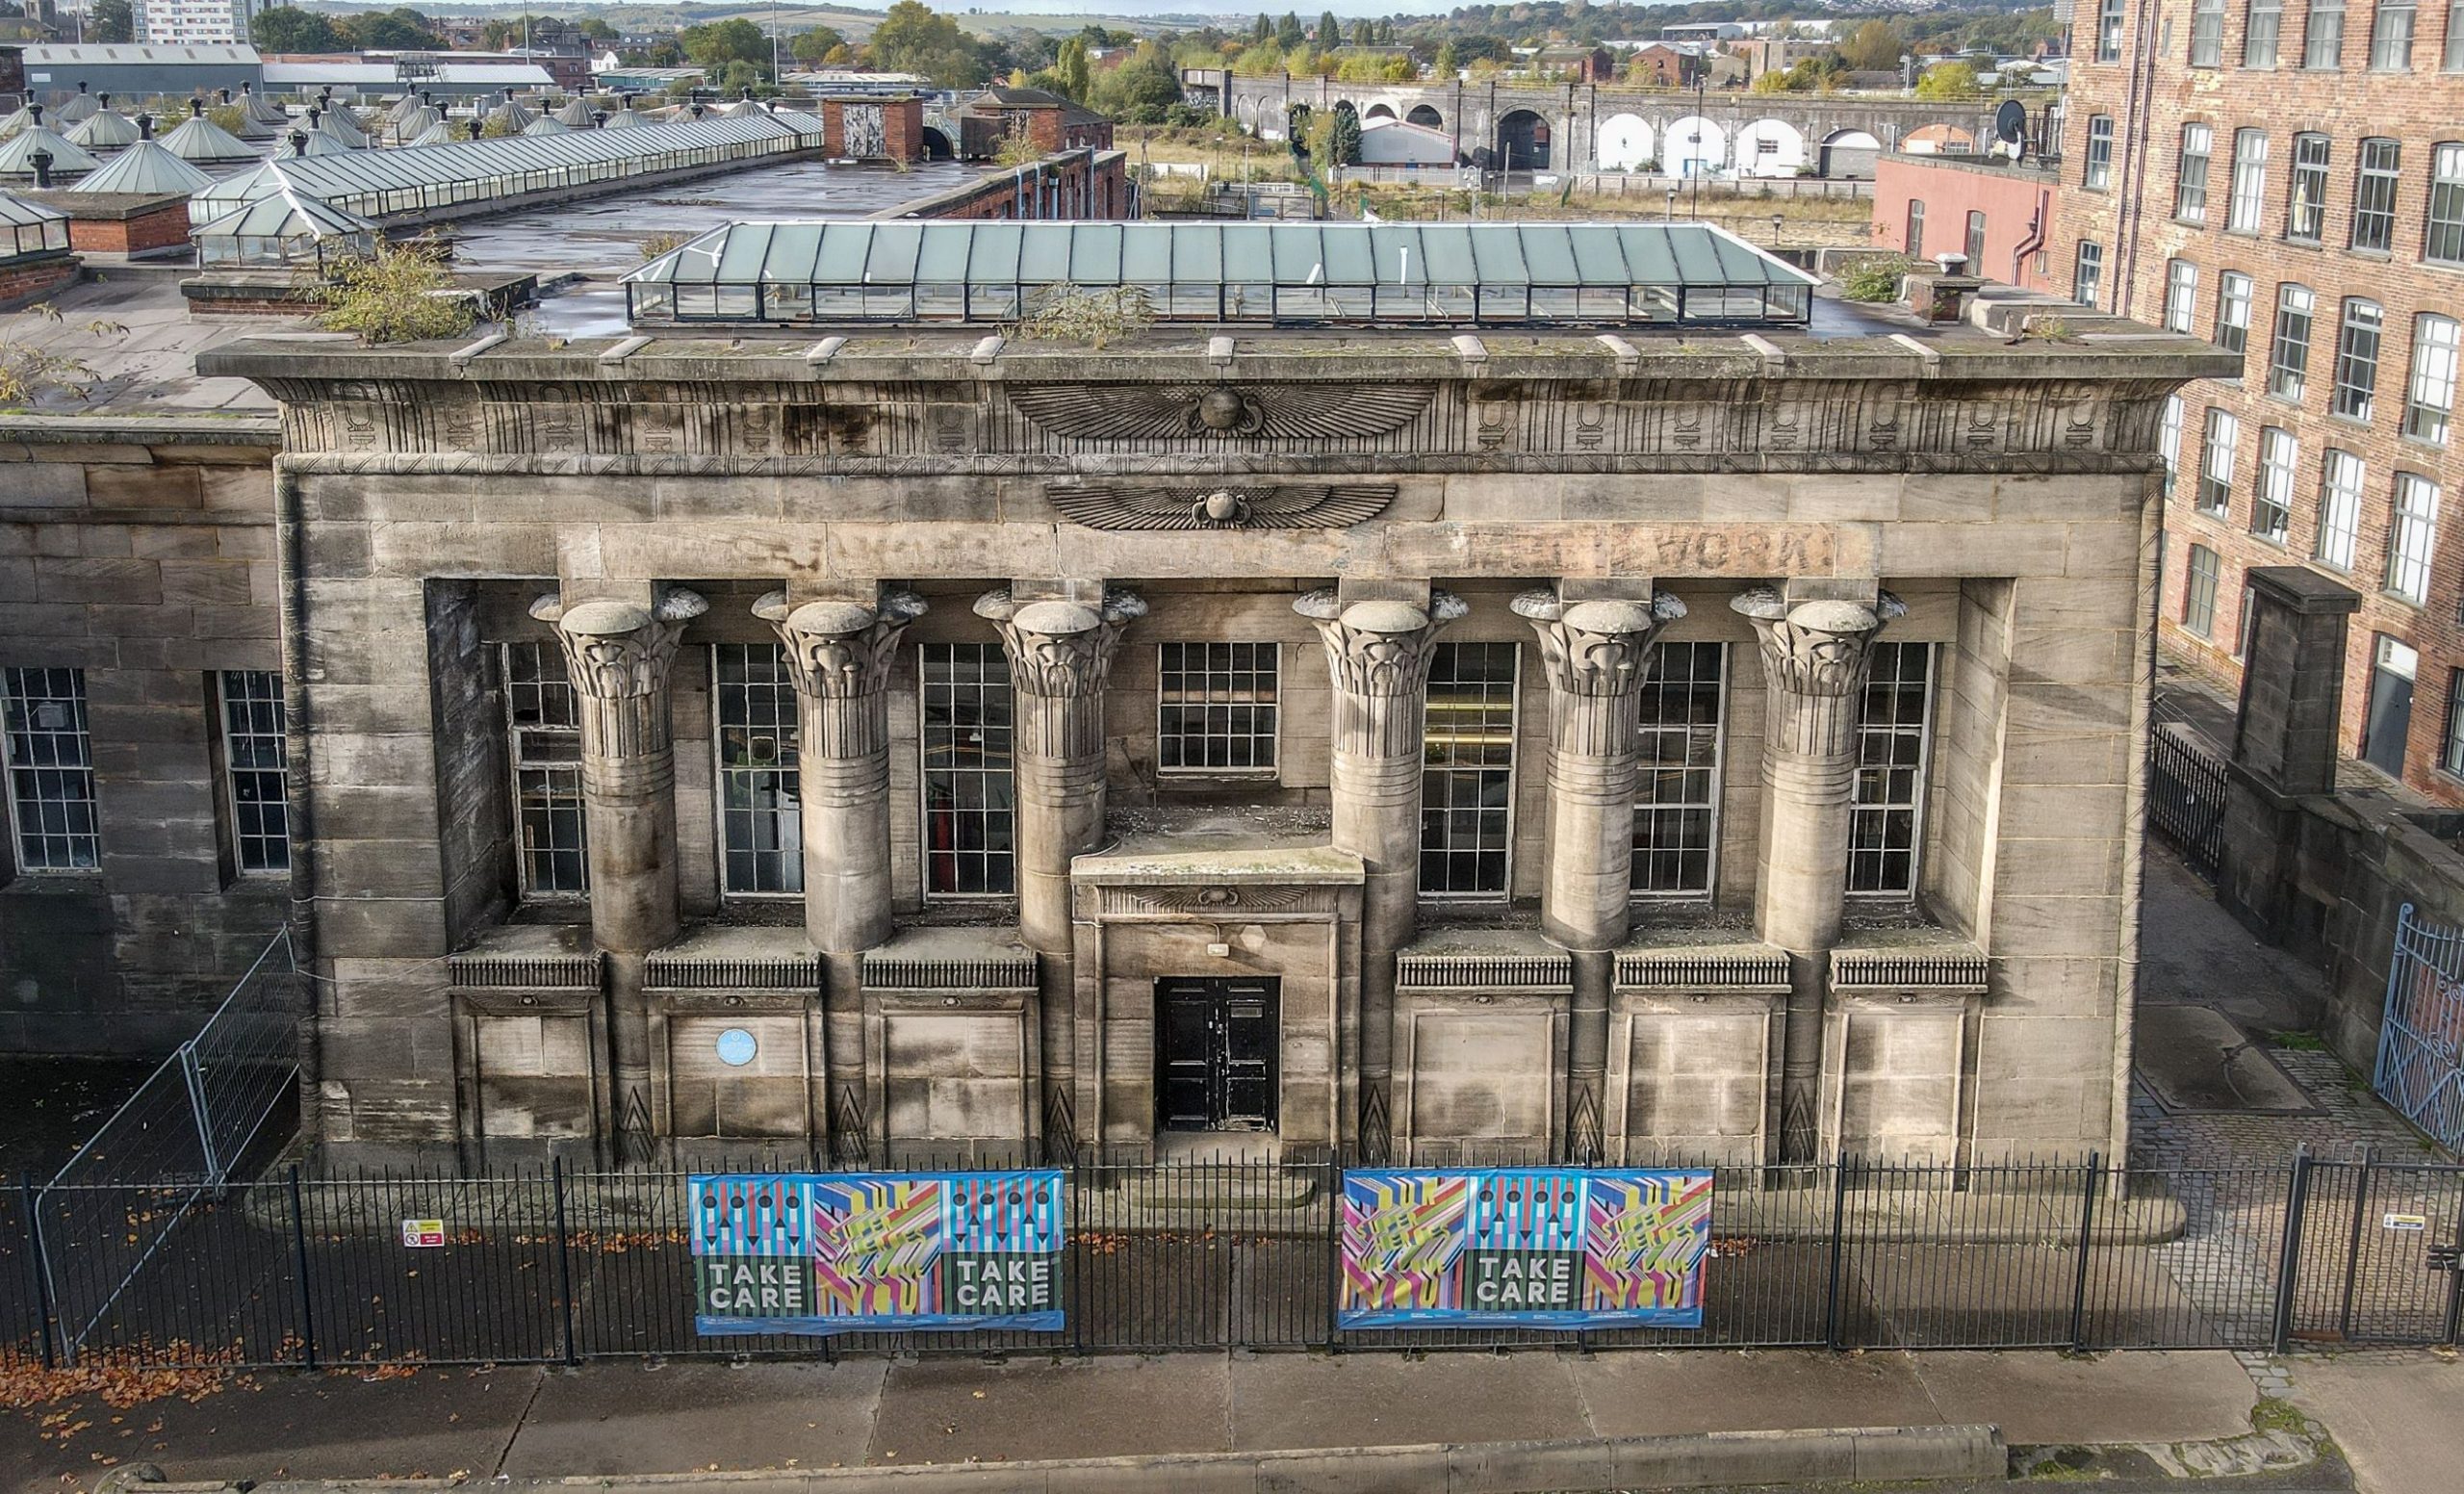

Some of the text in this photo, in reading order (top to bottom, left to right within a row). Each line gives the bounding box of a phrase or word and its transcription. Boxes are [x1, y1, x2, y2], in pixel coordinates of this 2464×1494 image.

[850, 1184, 910, 1216] OUR
[1377, 1179, 1438, 1211] OUR
[1624, 1179, 1683, 1211] OUR
[708, 1263, 801, 1285] TAKE
[957, 1260, 1049, 1282] TAKE
[1478, 1257, 1570, 1279] TAKE
[710, 1287, 802, 1308] CARE
[850, 1281, 917, 1315] YOU
[957, 1284, 1049, 1306] CARE
[1373, 1276, 1438, 1309] YOU
[1476, 1280, 1569, 1303] CARE
[1617, 1276, 1683, 1309] YOU
